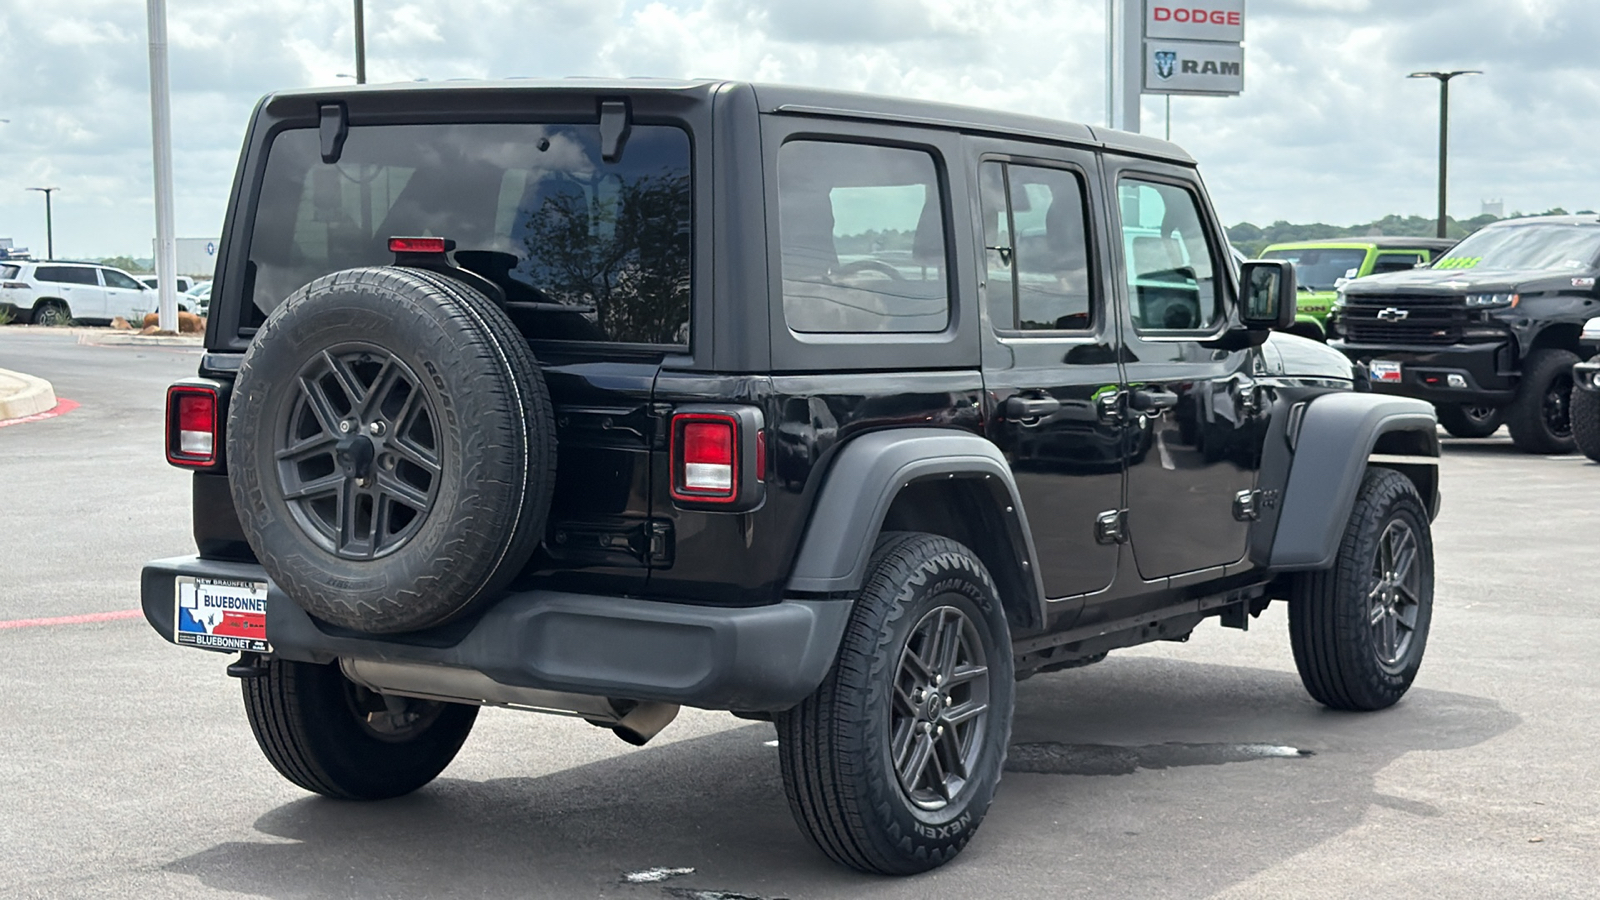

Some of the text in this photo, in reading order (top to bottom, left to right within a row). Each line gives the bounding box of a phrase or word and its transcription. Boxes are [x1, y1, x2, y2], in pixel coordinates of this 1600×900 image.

[1154, 7, 1240, 25] DODGE
[1181, 60, 1239, 76] RAM
[204, 595, 267, 611] BLUEBONNET
[196, 635, 250, 649] BLUEBONNET
[914, 811, 972, 839] NEXEN
